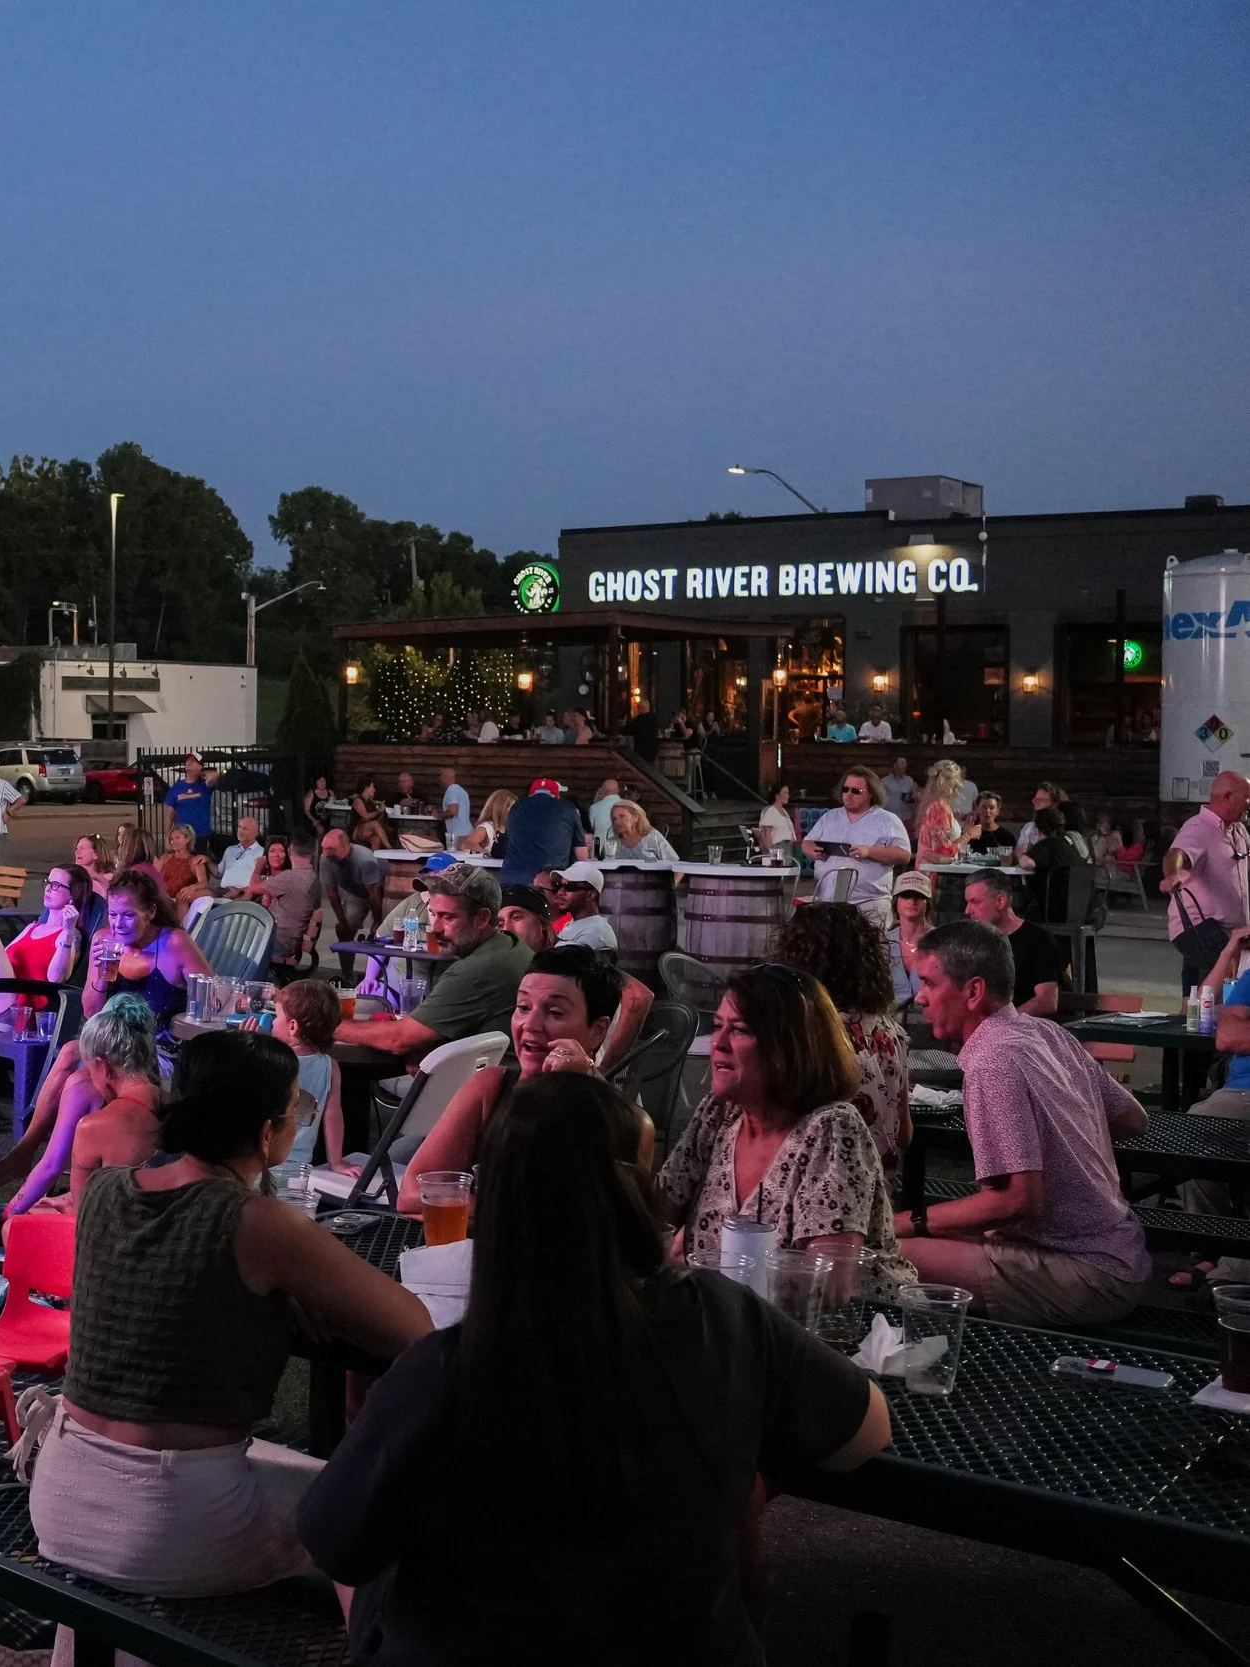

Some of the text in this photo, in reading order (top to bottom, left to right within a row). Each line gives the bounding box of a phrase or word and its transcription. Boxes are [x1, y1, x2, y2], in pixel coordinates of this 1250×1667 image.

[513, 566, 552, 585] GHOST RIVER
[588, 557, 979, 602] GHOST RIVER BREWING CO.
[1200, 727, 1228, 740] 3 0
